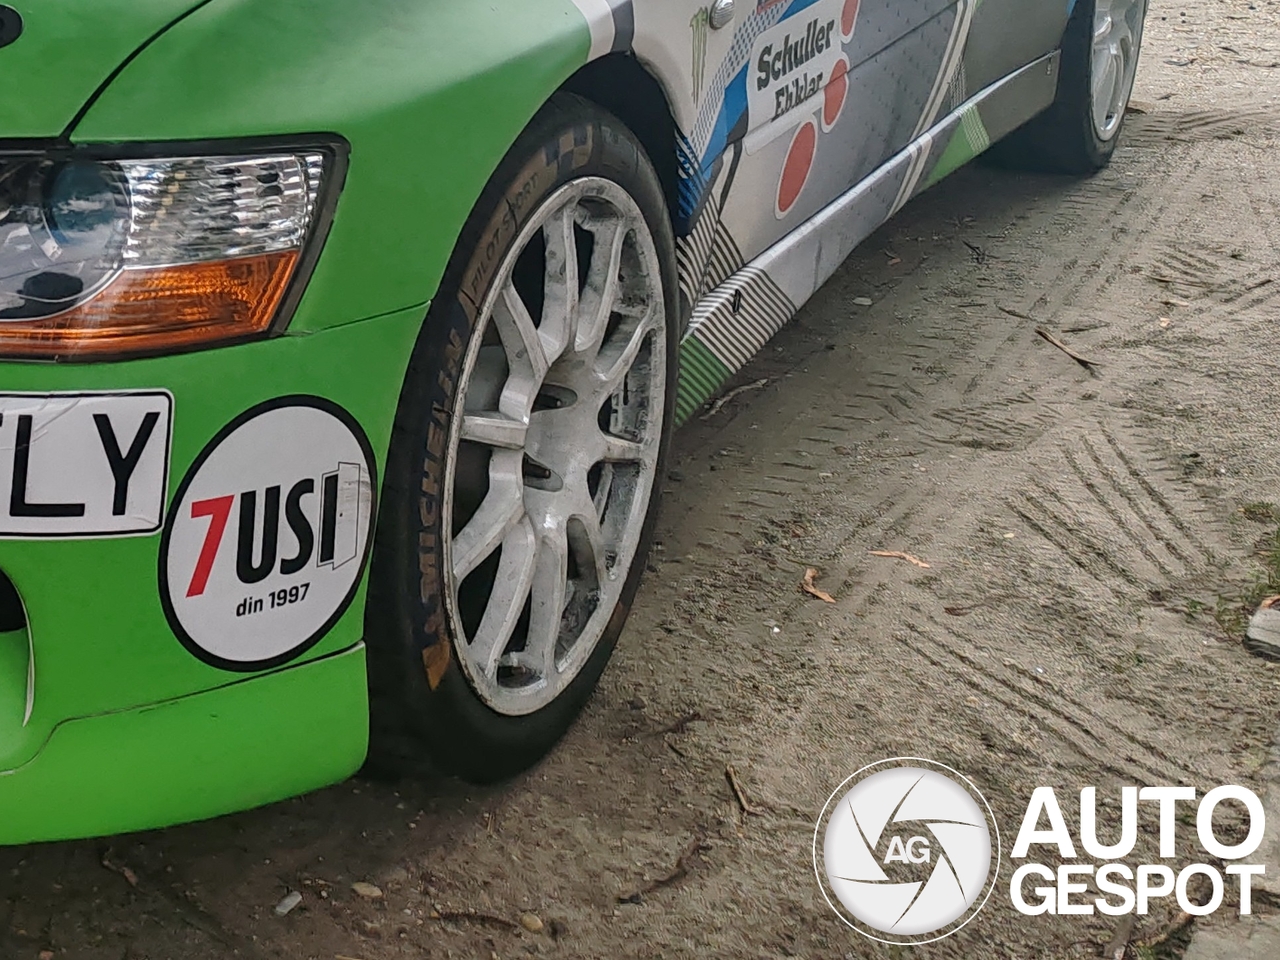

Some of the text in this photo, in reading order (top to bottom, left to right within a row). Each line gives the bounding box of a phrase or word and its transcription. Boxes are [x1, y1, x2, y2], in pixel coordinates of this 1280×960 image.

[757, 18, 835, 91] Schuller
[471, 228, 500, 296] PILOT
[235, 582, 310, 617] din 1997
